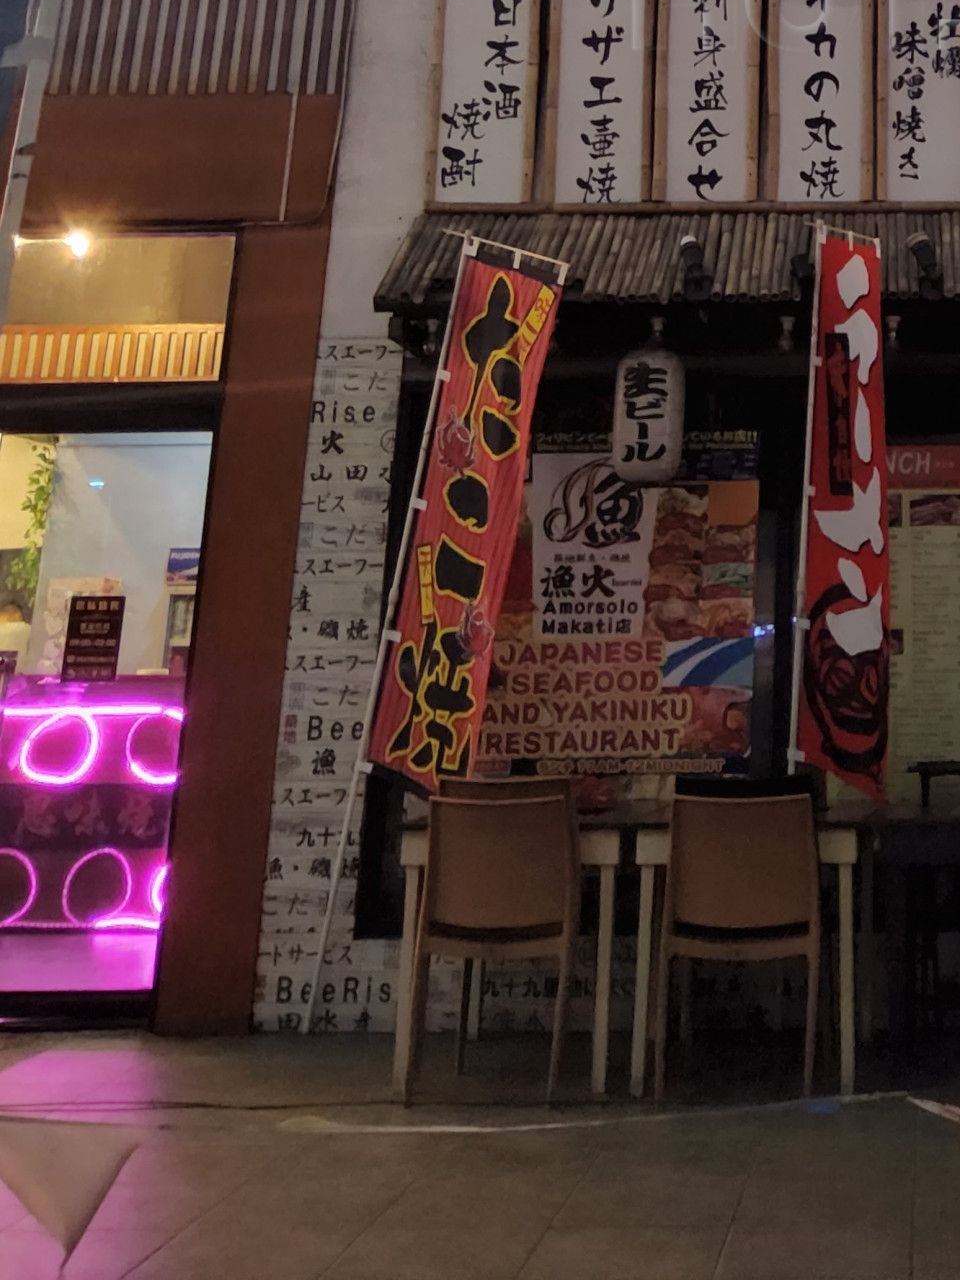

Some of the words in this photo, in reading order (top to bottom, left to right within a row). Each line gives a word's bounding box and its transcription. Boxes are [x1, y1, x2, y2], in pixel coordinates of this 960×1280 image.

[441, 101, 486, 190] 焼酎
[311, 399, 376, 425] Rise
[621, 360, 669, 462] 生ビール
[321, 430, 345, 456] 火
[539, 564, 615, 599] 漁火
[542, 599, 638, 615] Amorsolo
[500, 641, 663, 666] JAPANESE
[512, 670, 659, 694] SEAFOOD
[484, 701, 539, 724] AND
[552, 700, 688, 723] YAKINIKU
[484, 730, 681, 756] RESTAURANT
[276, 975, 392, 1004] BeeRis
